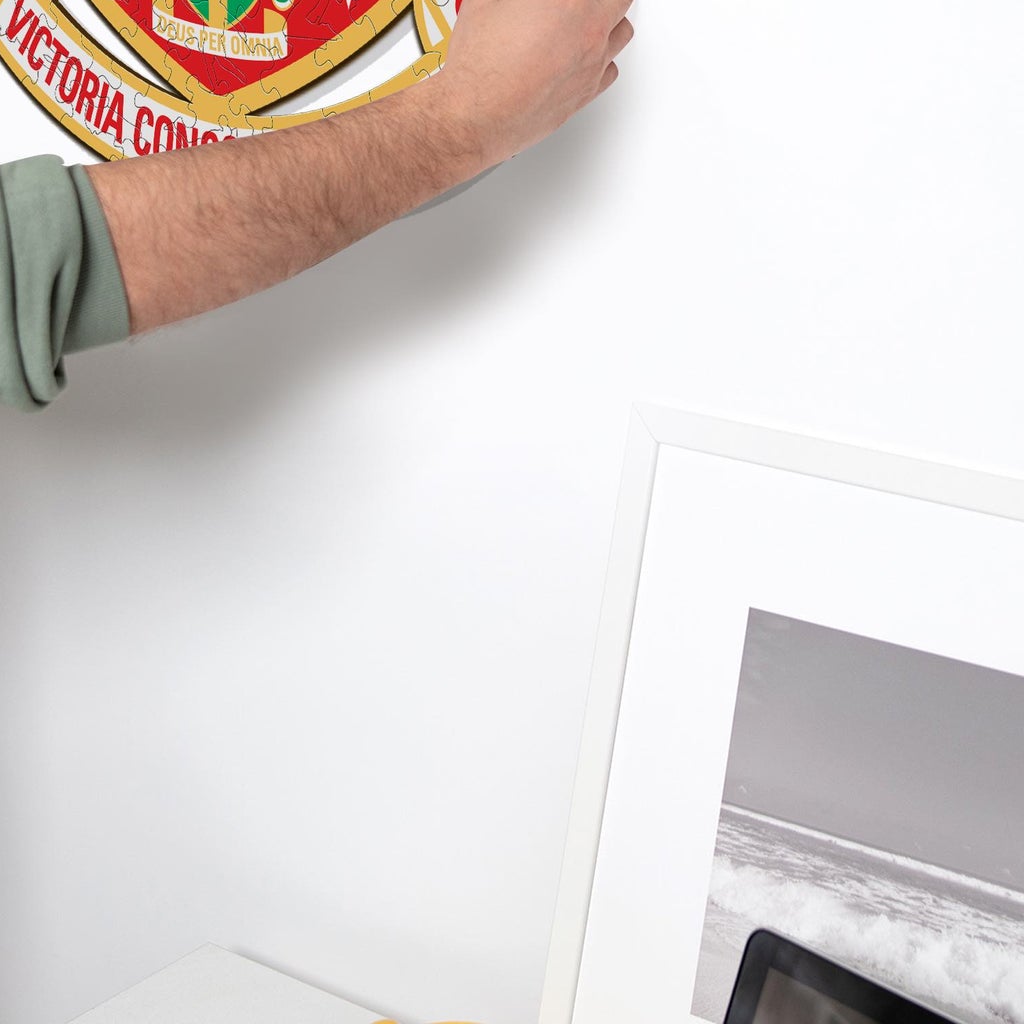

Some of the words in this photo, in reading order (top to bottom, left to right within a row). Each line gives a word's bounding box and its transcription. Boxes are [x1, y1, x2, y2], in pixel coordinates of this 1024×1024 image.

[157, 14, 195, 46] DEUS
[199, 29, 226, 53] PER
[230, 34, 285, 58] OMNIA
